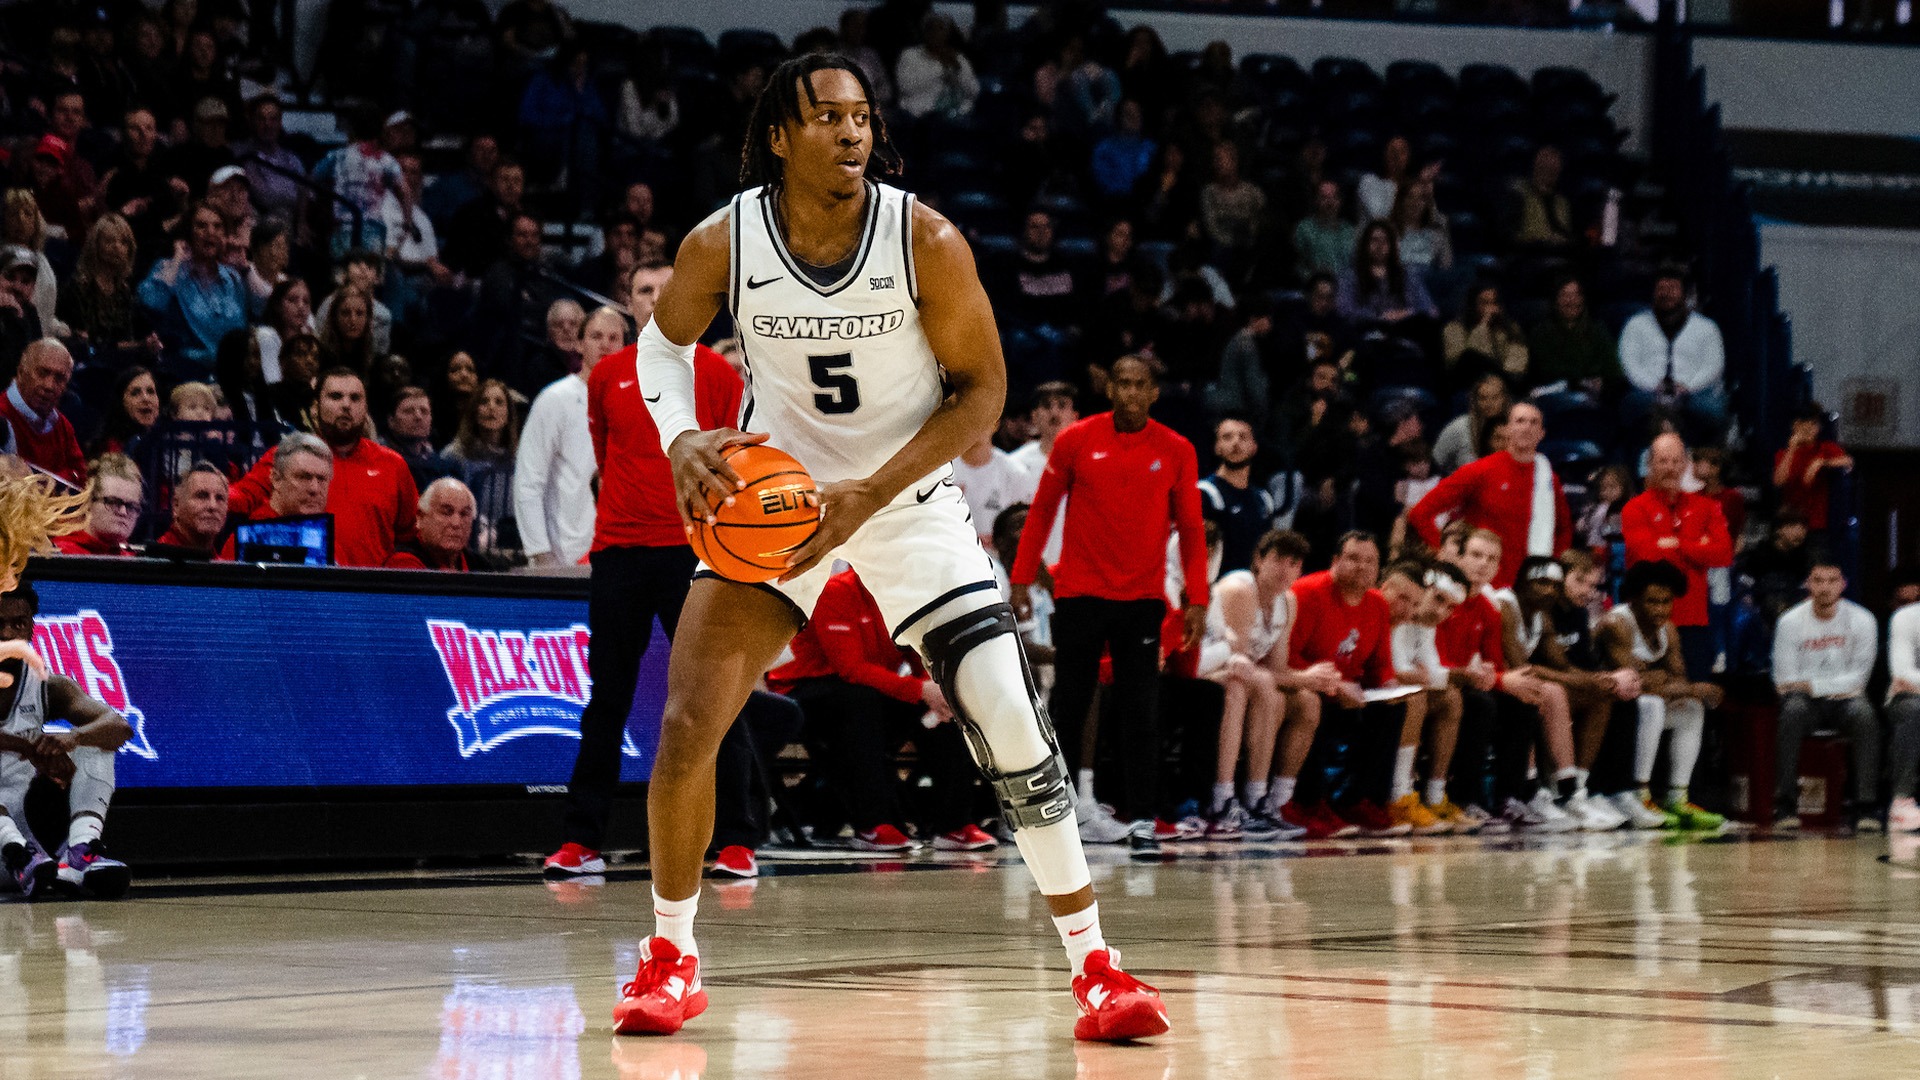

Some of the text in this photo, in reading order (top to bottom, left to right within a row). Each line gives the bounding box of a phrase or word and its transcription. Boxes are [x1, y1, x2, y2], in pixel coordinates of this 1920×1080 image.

[752, 309, 904, 340] SAMFORD
[807, 351, 861, 415] 5
[760, 488, 815, 515] ELIT
